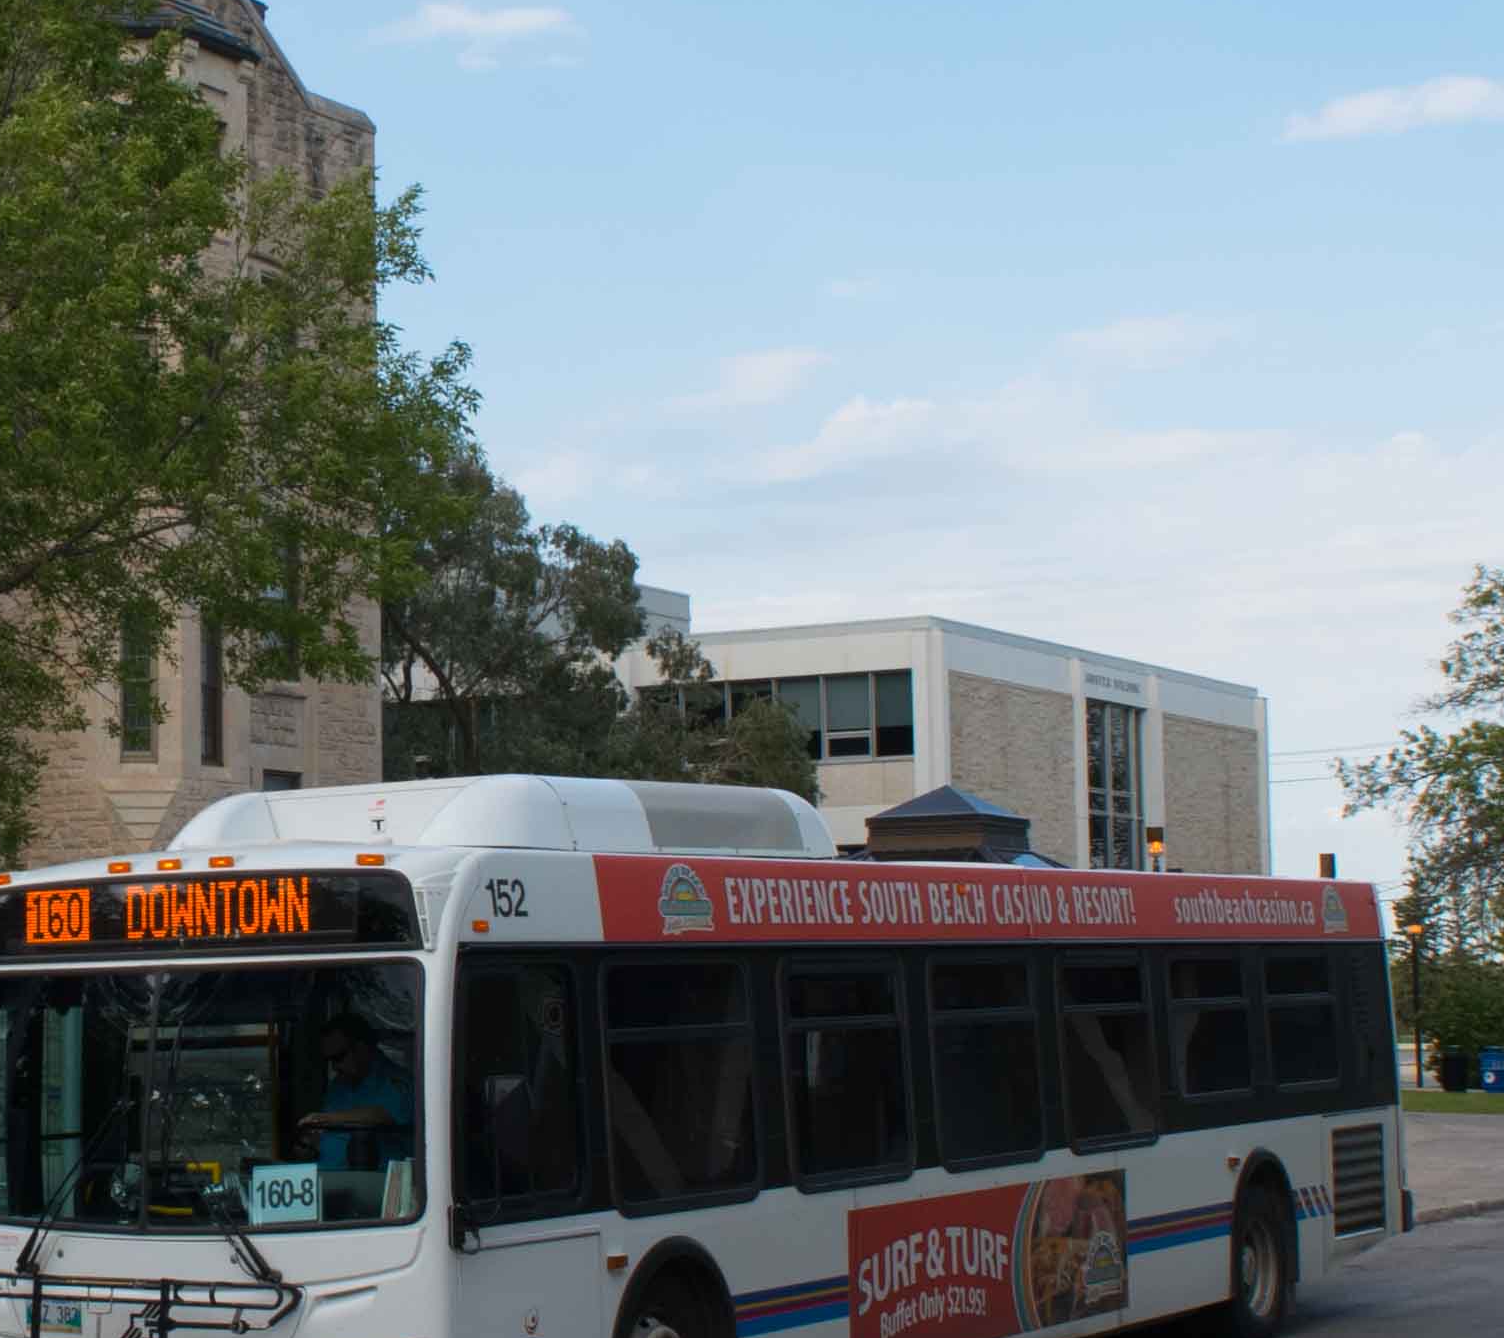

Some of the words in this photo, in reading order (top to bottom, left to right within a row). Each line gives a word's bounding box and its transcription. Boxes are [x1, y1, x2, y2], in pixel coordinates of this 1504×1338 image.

[32, 892, 84, 939] 160
[126, 876, 311, 940] DOWNTOWN
[486, 878, 529, 920] 152
[724, 876, 854, 925] EXPERIENCE
[858, 880, 923, 925] SOUTH
[927, 881, 988, 925] BEACH
[991, 883, 1053, 924] CASINO
[1056, 885, 1071, 923] &
[1072, 886, 1137, 925] RESORT!
[1173, 888, 1316, 926] southbeachcasino.ca
[255, 1177, 315, 1210] 160-8
[919, 1287, 945, 1324] Only
